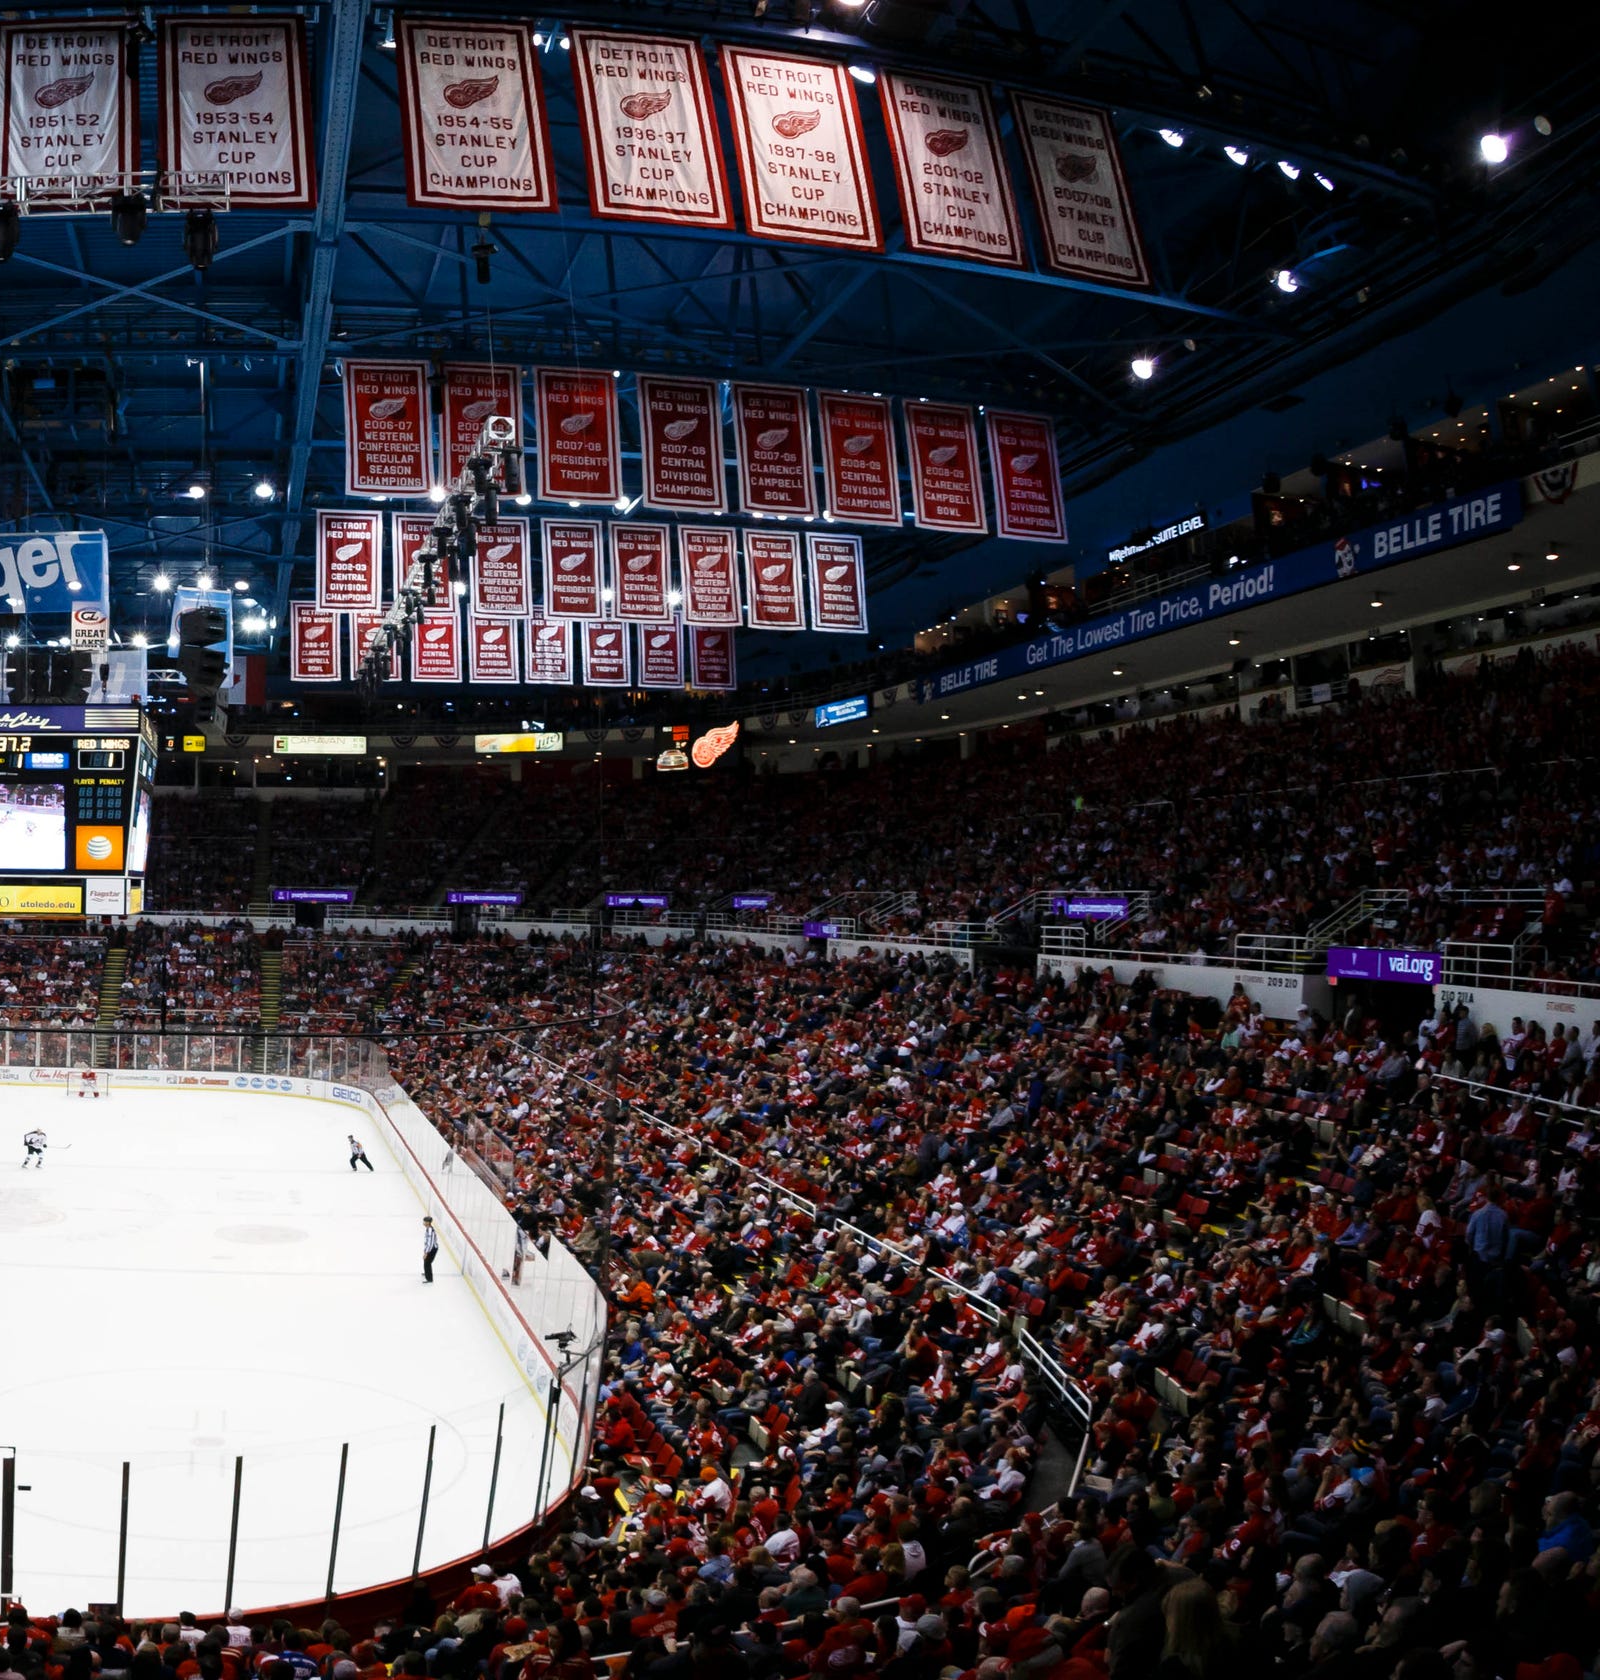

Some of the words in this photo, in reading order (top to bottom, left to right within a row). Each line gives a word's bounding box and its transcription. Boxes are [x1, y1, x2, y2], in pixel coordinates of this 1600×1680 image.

[190, 34, 271, 47] DETROIT
[427, 35, 505, 52] DETROIT
[181, 52, 218, 65] RED
[228, 51, 283, 64] WINGS
[420, 52, 455, 66] RED
[464, 56, 517, 71] WINGS
[751, 65, 822, 86] DETROIT
[747, 81, 779, 96] RED
[787, 87, 834, 105] WINGS
[196, 112, 273, 125] 1953-54
[436, 115, 513, 130] 1954-55
[193, 131, 278, 144] STANLEY
[435, 134, 518, 150] STANLEY
[218, 152, 256, 164] CUP
[768, 144, 836, 164] 1997-98
[461, 155, 498, 168] CUP
[768, 162, 841, 184] STANLEY
[430, 173, 532, 192] CHAMPIONS
[792, 186, 825, 201] CUP
[765, 203, 858, 227] CHAMPIONS
[357, 384, 380, 394] RED
[383, 385, 417, 396] WINGS
[364, 420, 413, 430] 2006-07
[364, 432, 414, 442] WESTERN
[358, 442, 421, 453] CONFERENCE
[366, 454, 414, 464] REGULAR
[369, 465, 412, 475] SEASON
[359, 476, 422, 487] CHAMPIONS
[331, 521, 367, 530] DETROIT
[1154, 526, 1179, 544] SUITE
[1179, 516, 1204, 536] LEVEL
[1373, 511, 1444, 559] BELLE
[1449, 493, 1502, 537] TIRE
[327, 530, 344, 539] RED
[346, 531, 371, 540] WINGS
[331, 563, 367, 571] 2002-03
[331, 572, 367, 582] CENTRAL
[330, 583, 368, 592] DIVISION
[326, 593, 372, 601] CHAMPIONS
[1026, 644, 1048, 665] Get
[1051, 637, 1074, 658] The
[1077, 620, 1125, 649] Lowest
[1128, 609, 1155, 634] Tire
[1159, 596, 1203, 623] Price,
[1208, 565, 1275, 610] Period!
[75, 629, 105, 638] GREAT
[940, 667, 970, 693] BELLE
[974, 659, 998, 682] TIRE
[78, 740, 97, 749] RED
[101, 740, 129, 749] WINGS
[17, 754, 23, 768] 1
[31, 753, 64, 763] DMC
[108, 753, 114, 768] 1
[90, 891, 120, 899] Flagstar
[20, 901, 76, 910] utoledo.edu
[1388, 955, 1434, 981] vai.org
[1267, 976, 1282, 988] 209
[1283, 978, 1298, 989] 210
[1441, 990, 1455, 1002] 210
[34, 1069, 50, 1079] Tim
[332, 1087, 361, 1104] GEICO
